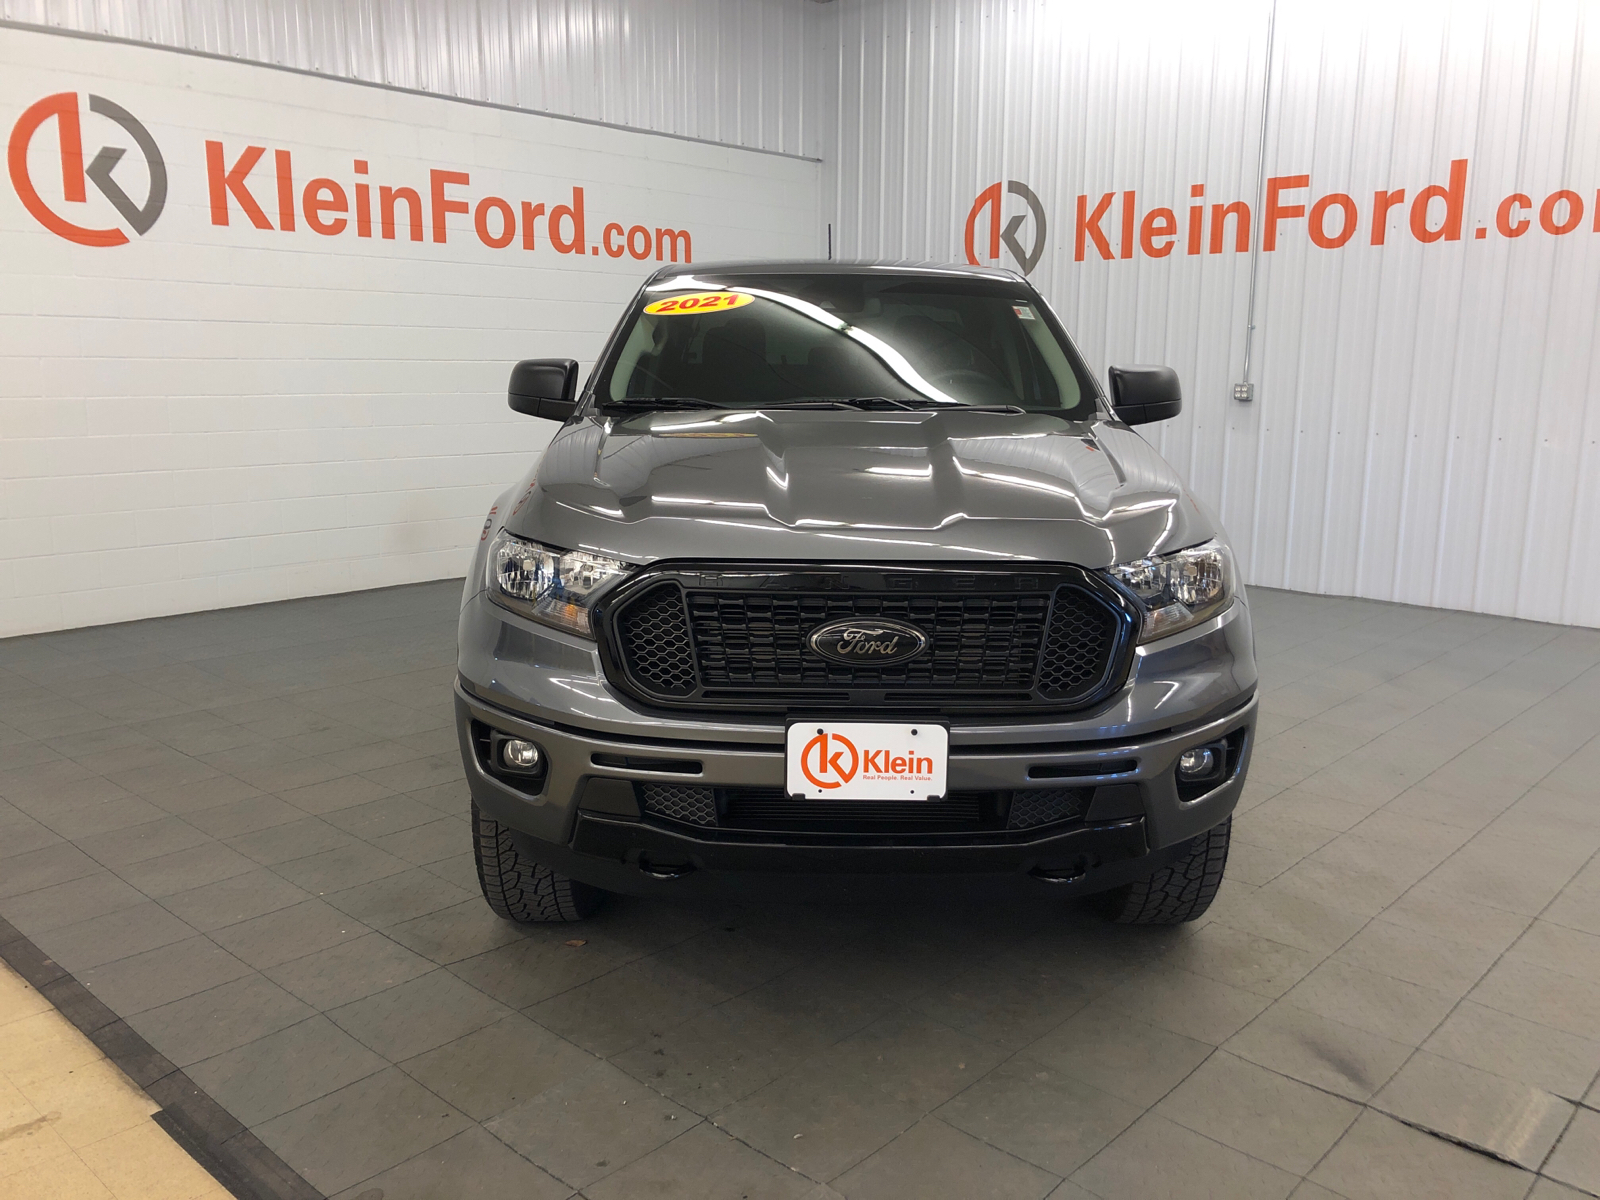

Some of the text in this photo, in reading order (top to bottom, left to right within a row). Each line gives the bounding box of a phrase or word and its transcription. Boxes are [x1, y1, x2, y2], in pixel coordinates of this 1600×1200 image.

[205, 140, 692, 264] KleinFord.com
[1074, 158, 1600, 262] KleinFord.co
[656, 294, 739, 313] 2021
[837, 628, 899, 654] Ford
[863, 749, 933, 774] Klein
